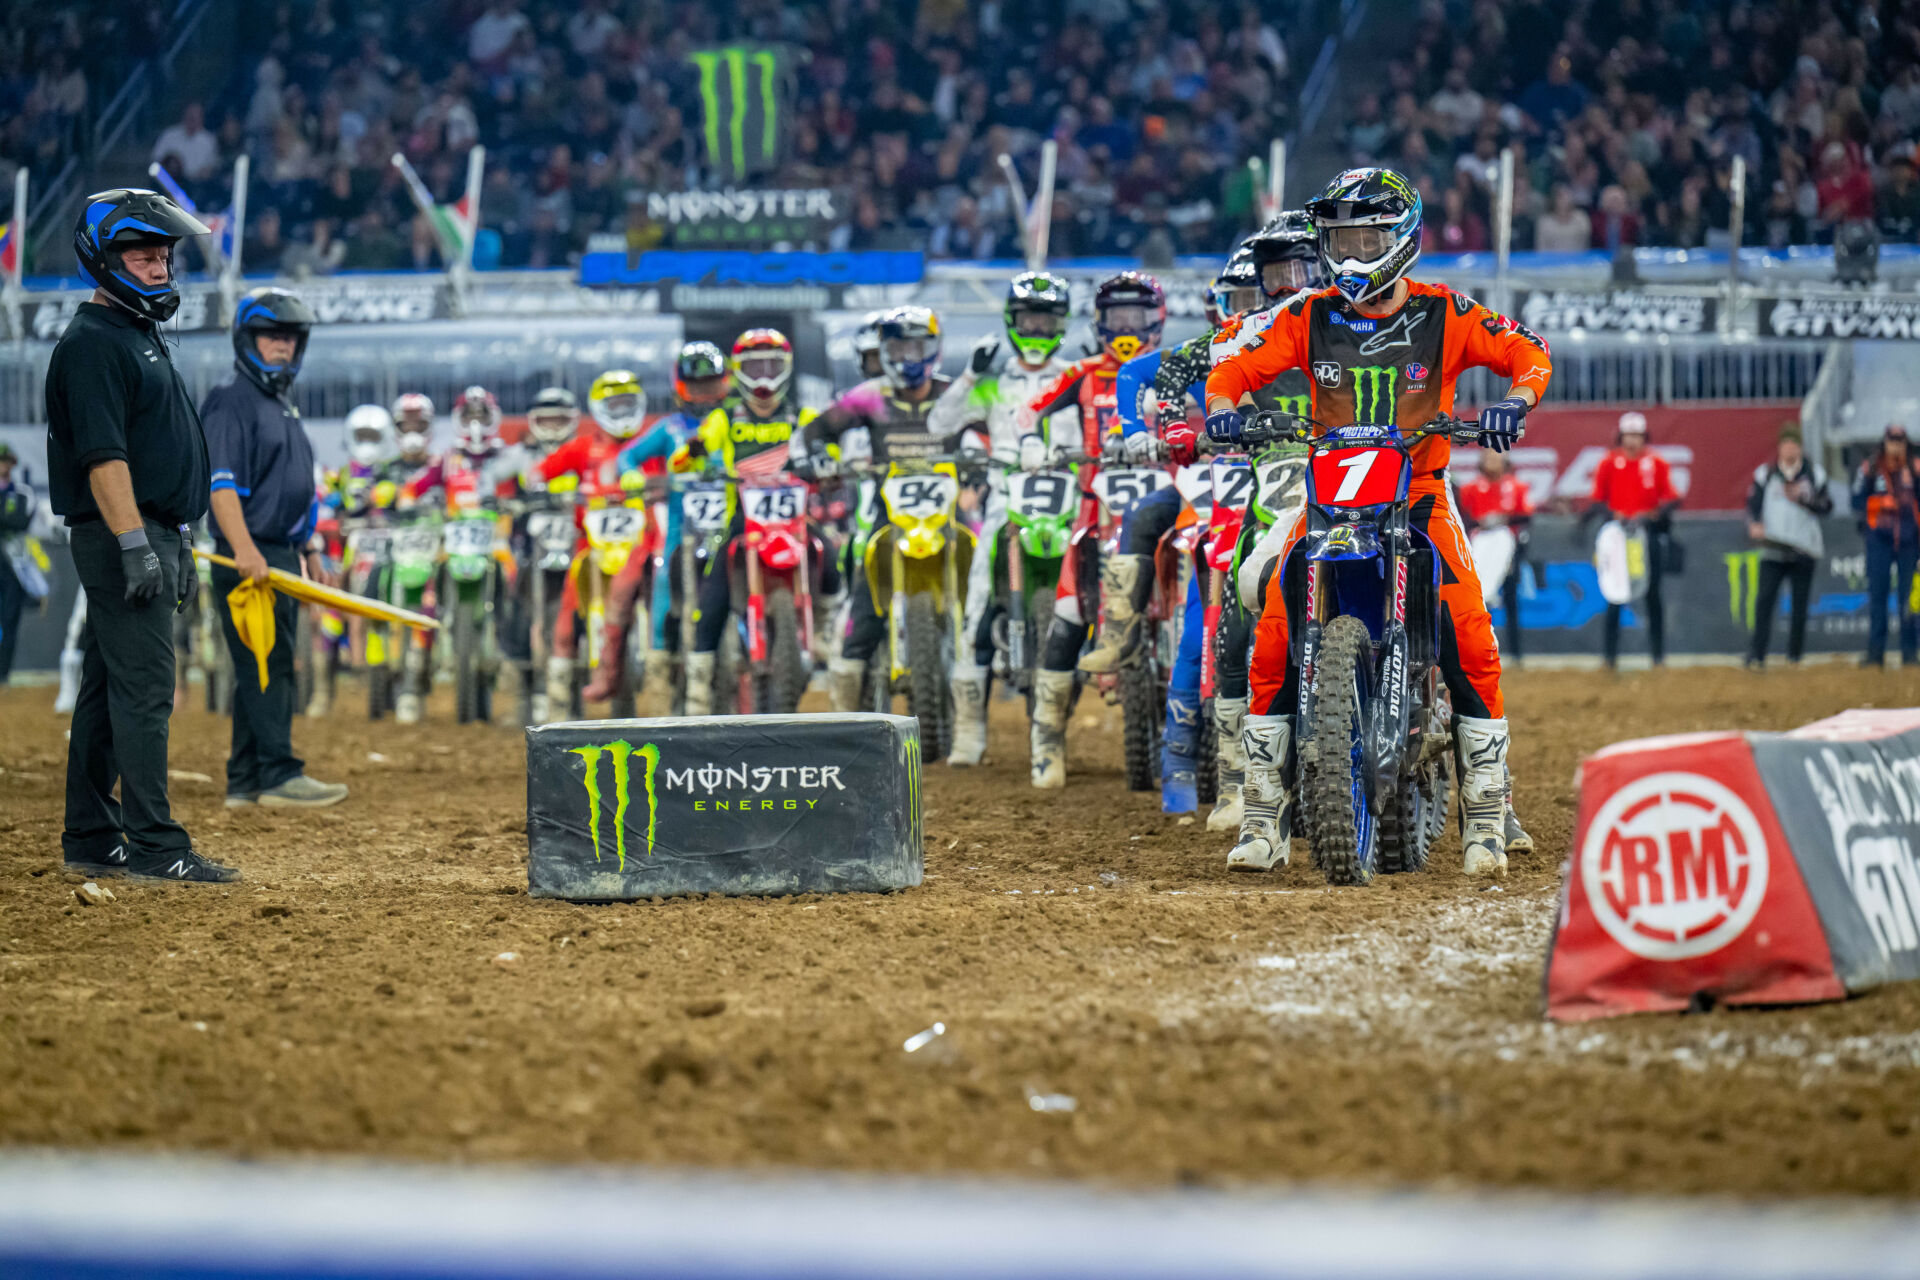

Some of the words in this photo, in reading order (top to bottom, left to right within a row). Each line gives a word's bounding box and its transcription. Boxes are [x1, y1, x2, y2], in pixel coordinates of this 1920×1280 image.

[648, 187, 836, 224] MONSTER
[1342, 320, 1374, 332] MAHA
[1314, 364, 1339, 384] PPG
[1407, 362, 1421, 380] VP
[1333, 450, 1380, 502] 1
[756, 495, 797, 520] 45
[899, 481, 945, 508] 94
[1022, 475, 1067, 515] 9
[1107, 473, 1156, 515] 51
[601, 515, 632, 535] 12
[1389, 644, 1403, 719] DUNLOP
[665, 762, 846, 795] MONSTER
[694, 799, 818, 811] ENERGY
